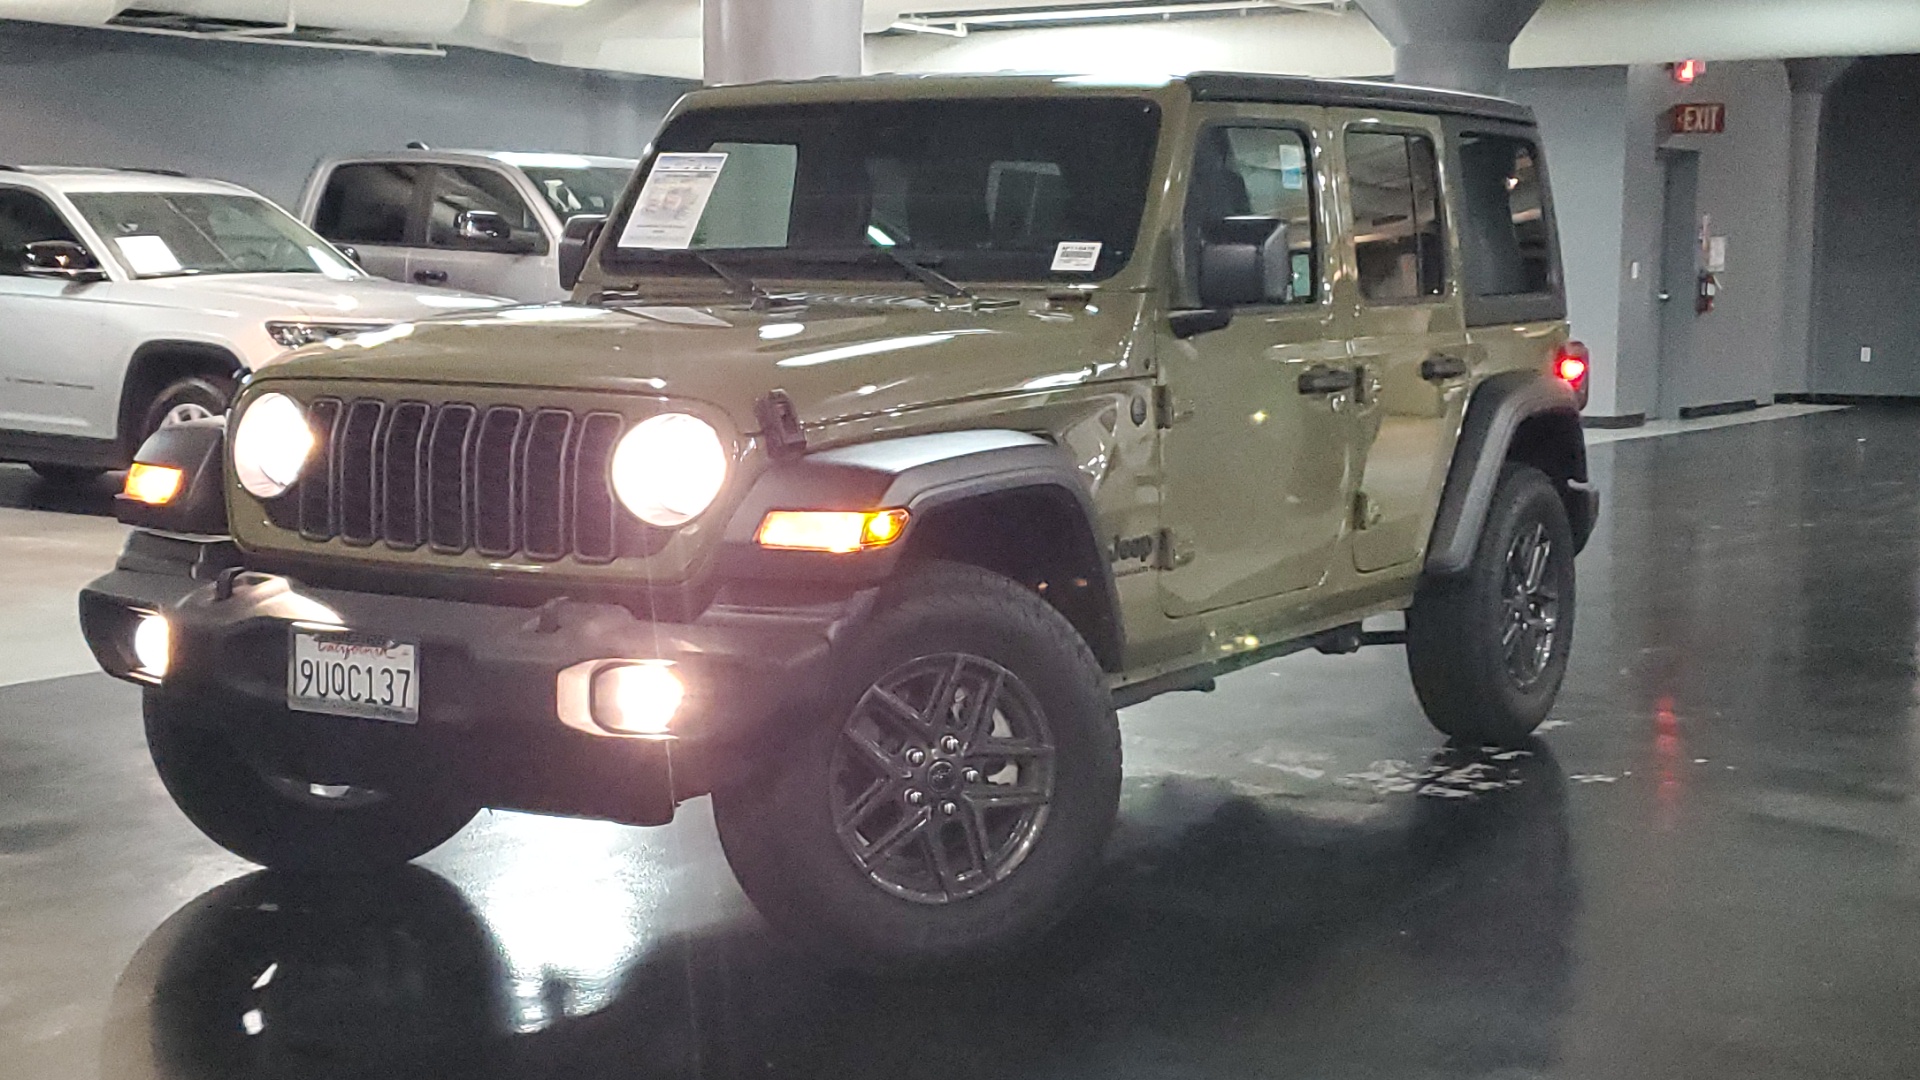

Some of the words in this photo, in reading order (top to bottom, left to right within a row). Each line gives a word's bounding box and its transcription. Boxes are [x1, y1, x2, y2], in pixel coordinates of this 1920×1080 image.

[1684, 106, 1719, 131] EXIT
[1110, 534, 1152, 562] Jeep
[300, 659, 411, 708] 9UQC137
